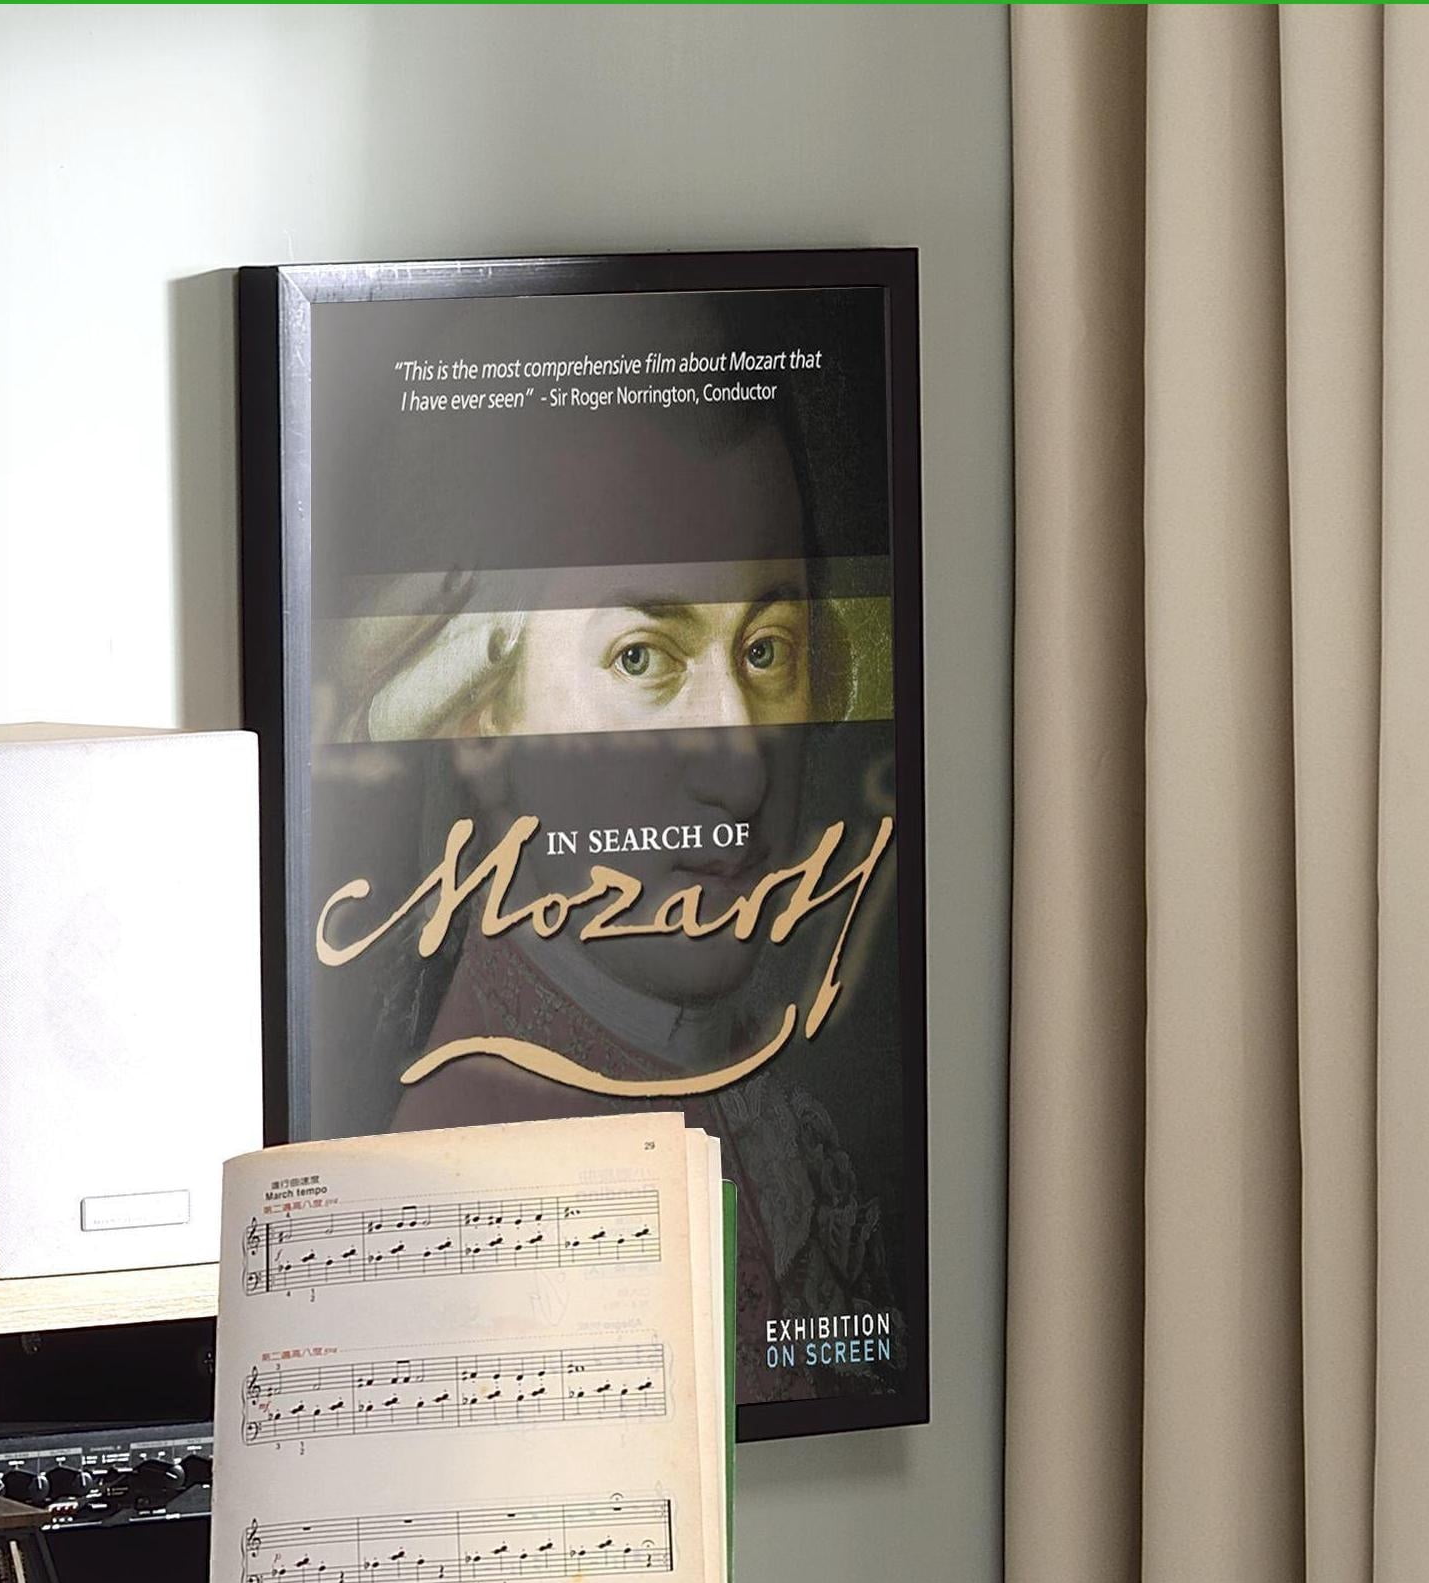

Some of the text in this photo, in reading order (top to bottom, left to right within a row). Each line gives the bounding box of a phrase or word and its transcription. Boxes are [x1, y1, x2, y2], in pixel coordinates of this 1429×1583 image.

[437, 360, 448, 380] is
[452, 359, 477, 380] the
[482, 359, 521, 379] most
[524, 354, 641, 381] comprehensive
[645, 352, 676, 374] film
[679, 352, 727, 373] about
[729, 351, 786, 371] Mozart
[790, 349, 822, 369] that
[401, 391, 407, 411] I
[409, 390, 447, 411] have
[451, 393, 486, 410] ever
[550, 388, 568, 407] Sir
[571, 387, 613, 410] Roger
[616, 385, 699, 408] Norrington,
[703, 382, 777, 402] Conductor
[546, 822, 750, 855] IN SEARCH OF
[315, 815, 894, 1039] Mozart
[644, 1141, 655, 1151] 29
[265, 1185, 328, 1201] March tempo
[766, 1313, 890, 1342] EXHIBITION
[766, 1338, 890, 1368] ON SCREEN
